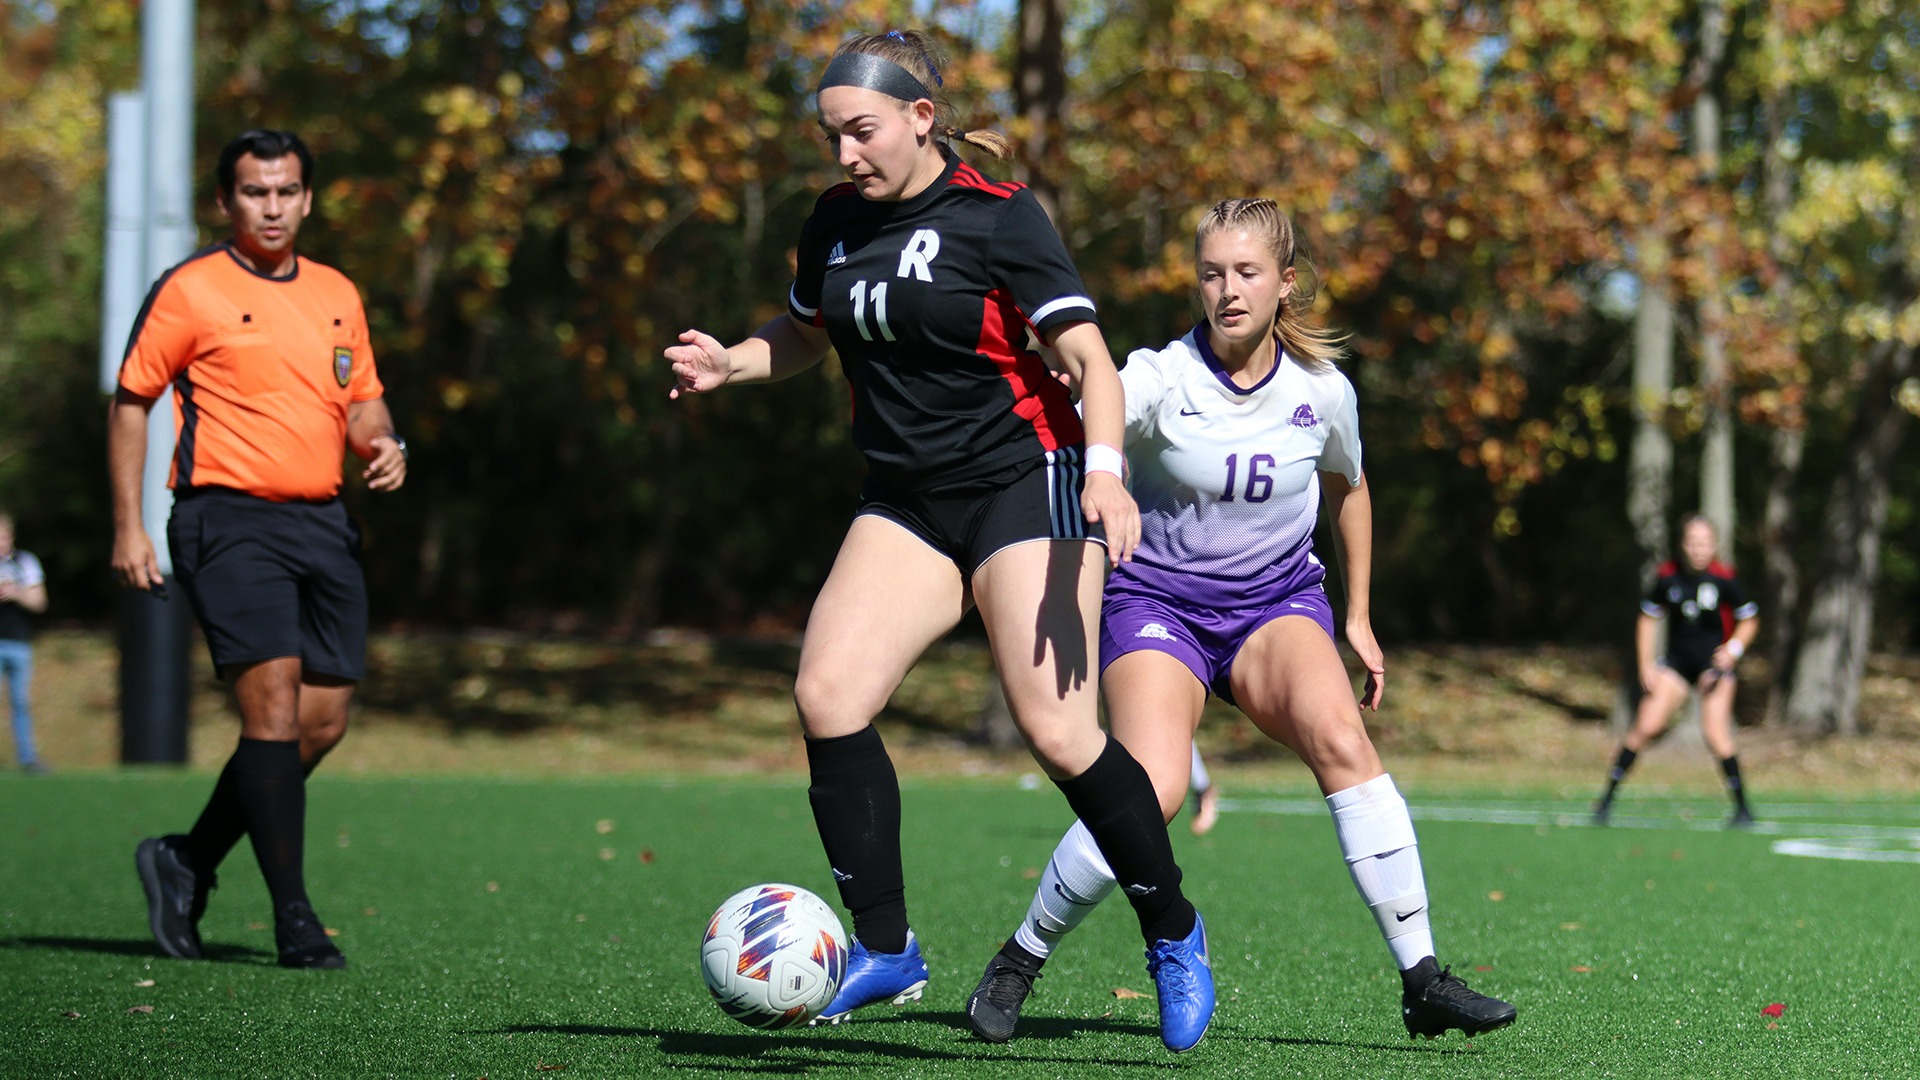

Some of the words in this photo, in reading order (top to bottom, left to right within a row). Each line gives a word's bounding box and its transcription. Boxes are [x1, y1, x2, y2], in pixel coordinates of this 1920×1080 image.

[897, 229, 940, 283] R
[850, 280, 897, 342] 11
[1220, 453, 1276, 504] 16
